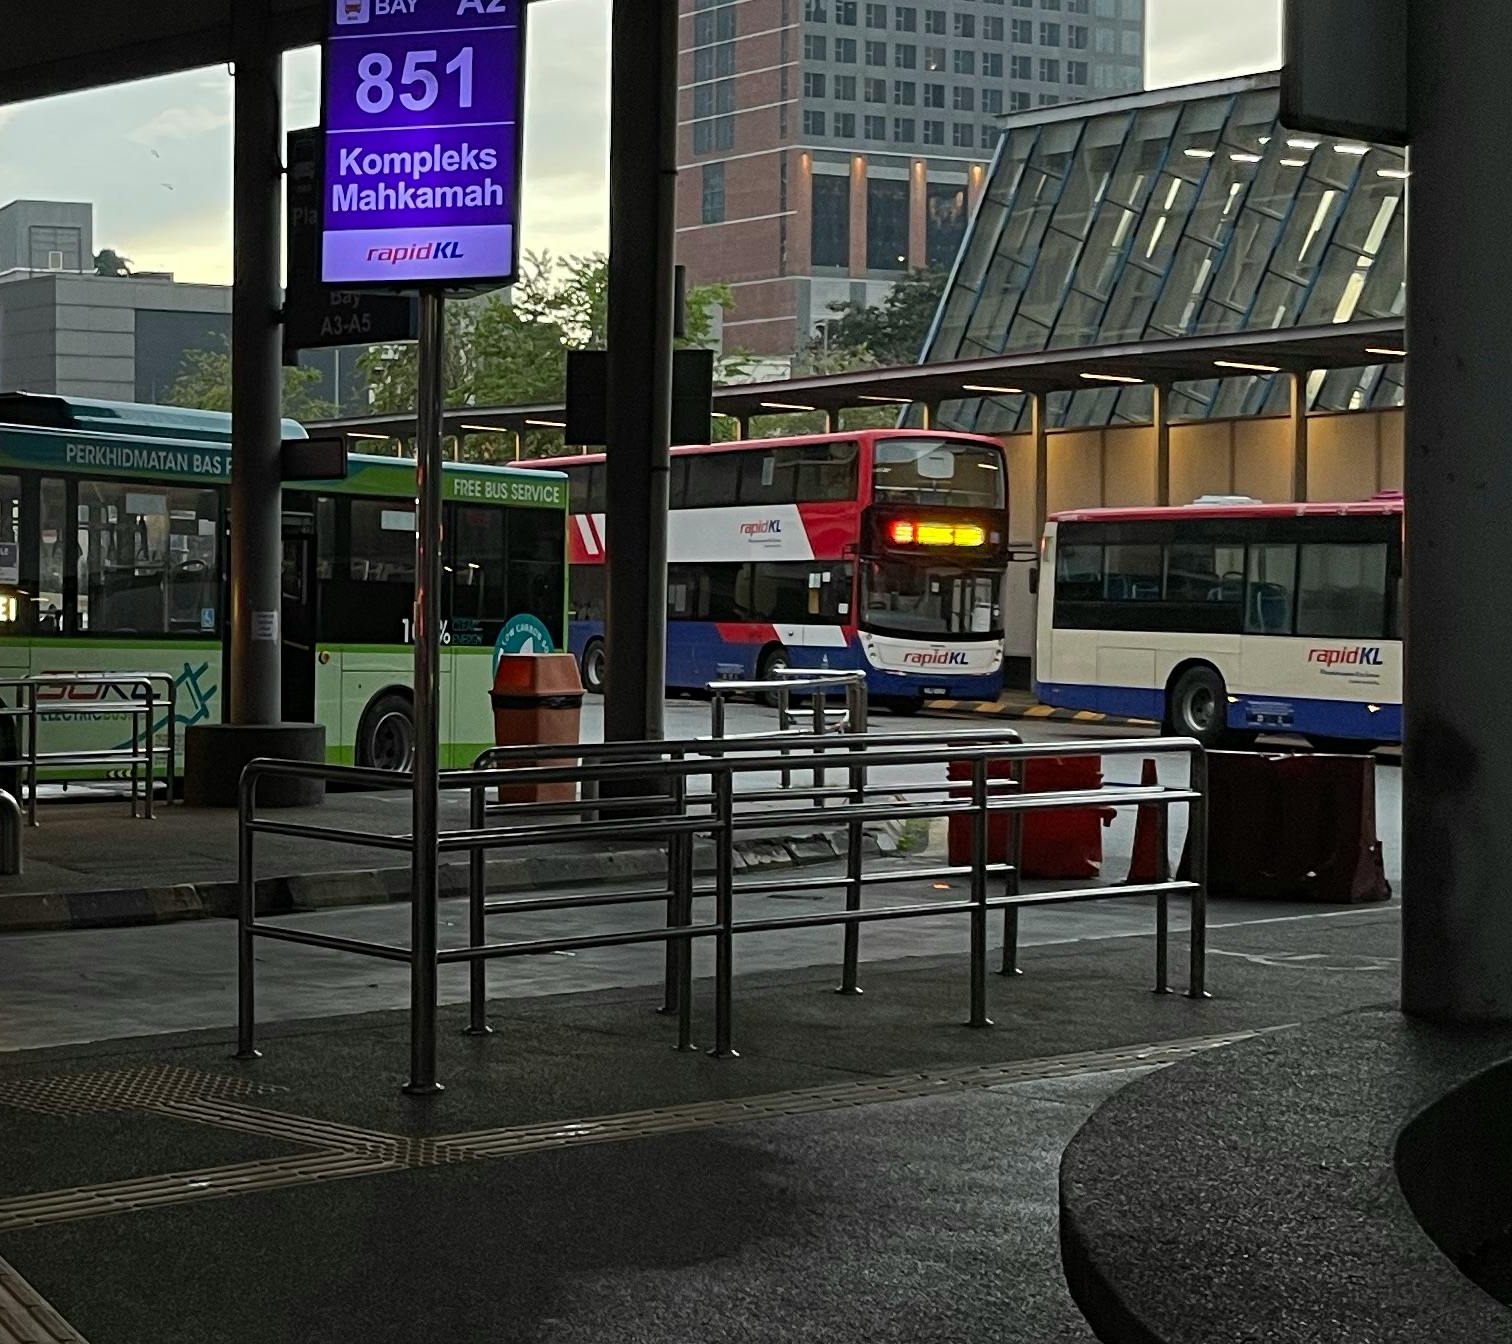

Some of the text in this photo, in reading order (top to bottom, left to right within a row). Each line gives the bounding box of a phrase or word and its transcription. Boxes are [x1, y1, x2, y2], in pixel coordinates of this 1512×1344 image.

[355, 46, 474, 115] 851
[338, 142, 498, 180] Kompleks
[331, 178, 503, 213] Mahkamah
[366, 240, 465, 265] rapidKL
[329, 290, 361, 309] Bay
[320, 312, 372, 337] A3-A5
[66, 443, 189, 471] PERKHIDMATAN
[192, 454, 222, 475] BAS
[453, 479, 560, 503] FREE BUS SERVICE
[740, 519, 781, 538] rapidKL
[904, 650, 969, 667] rapidKL
[1308, 646, 1383, 667] rapidKL
